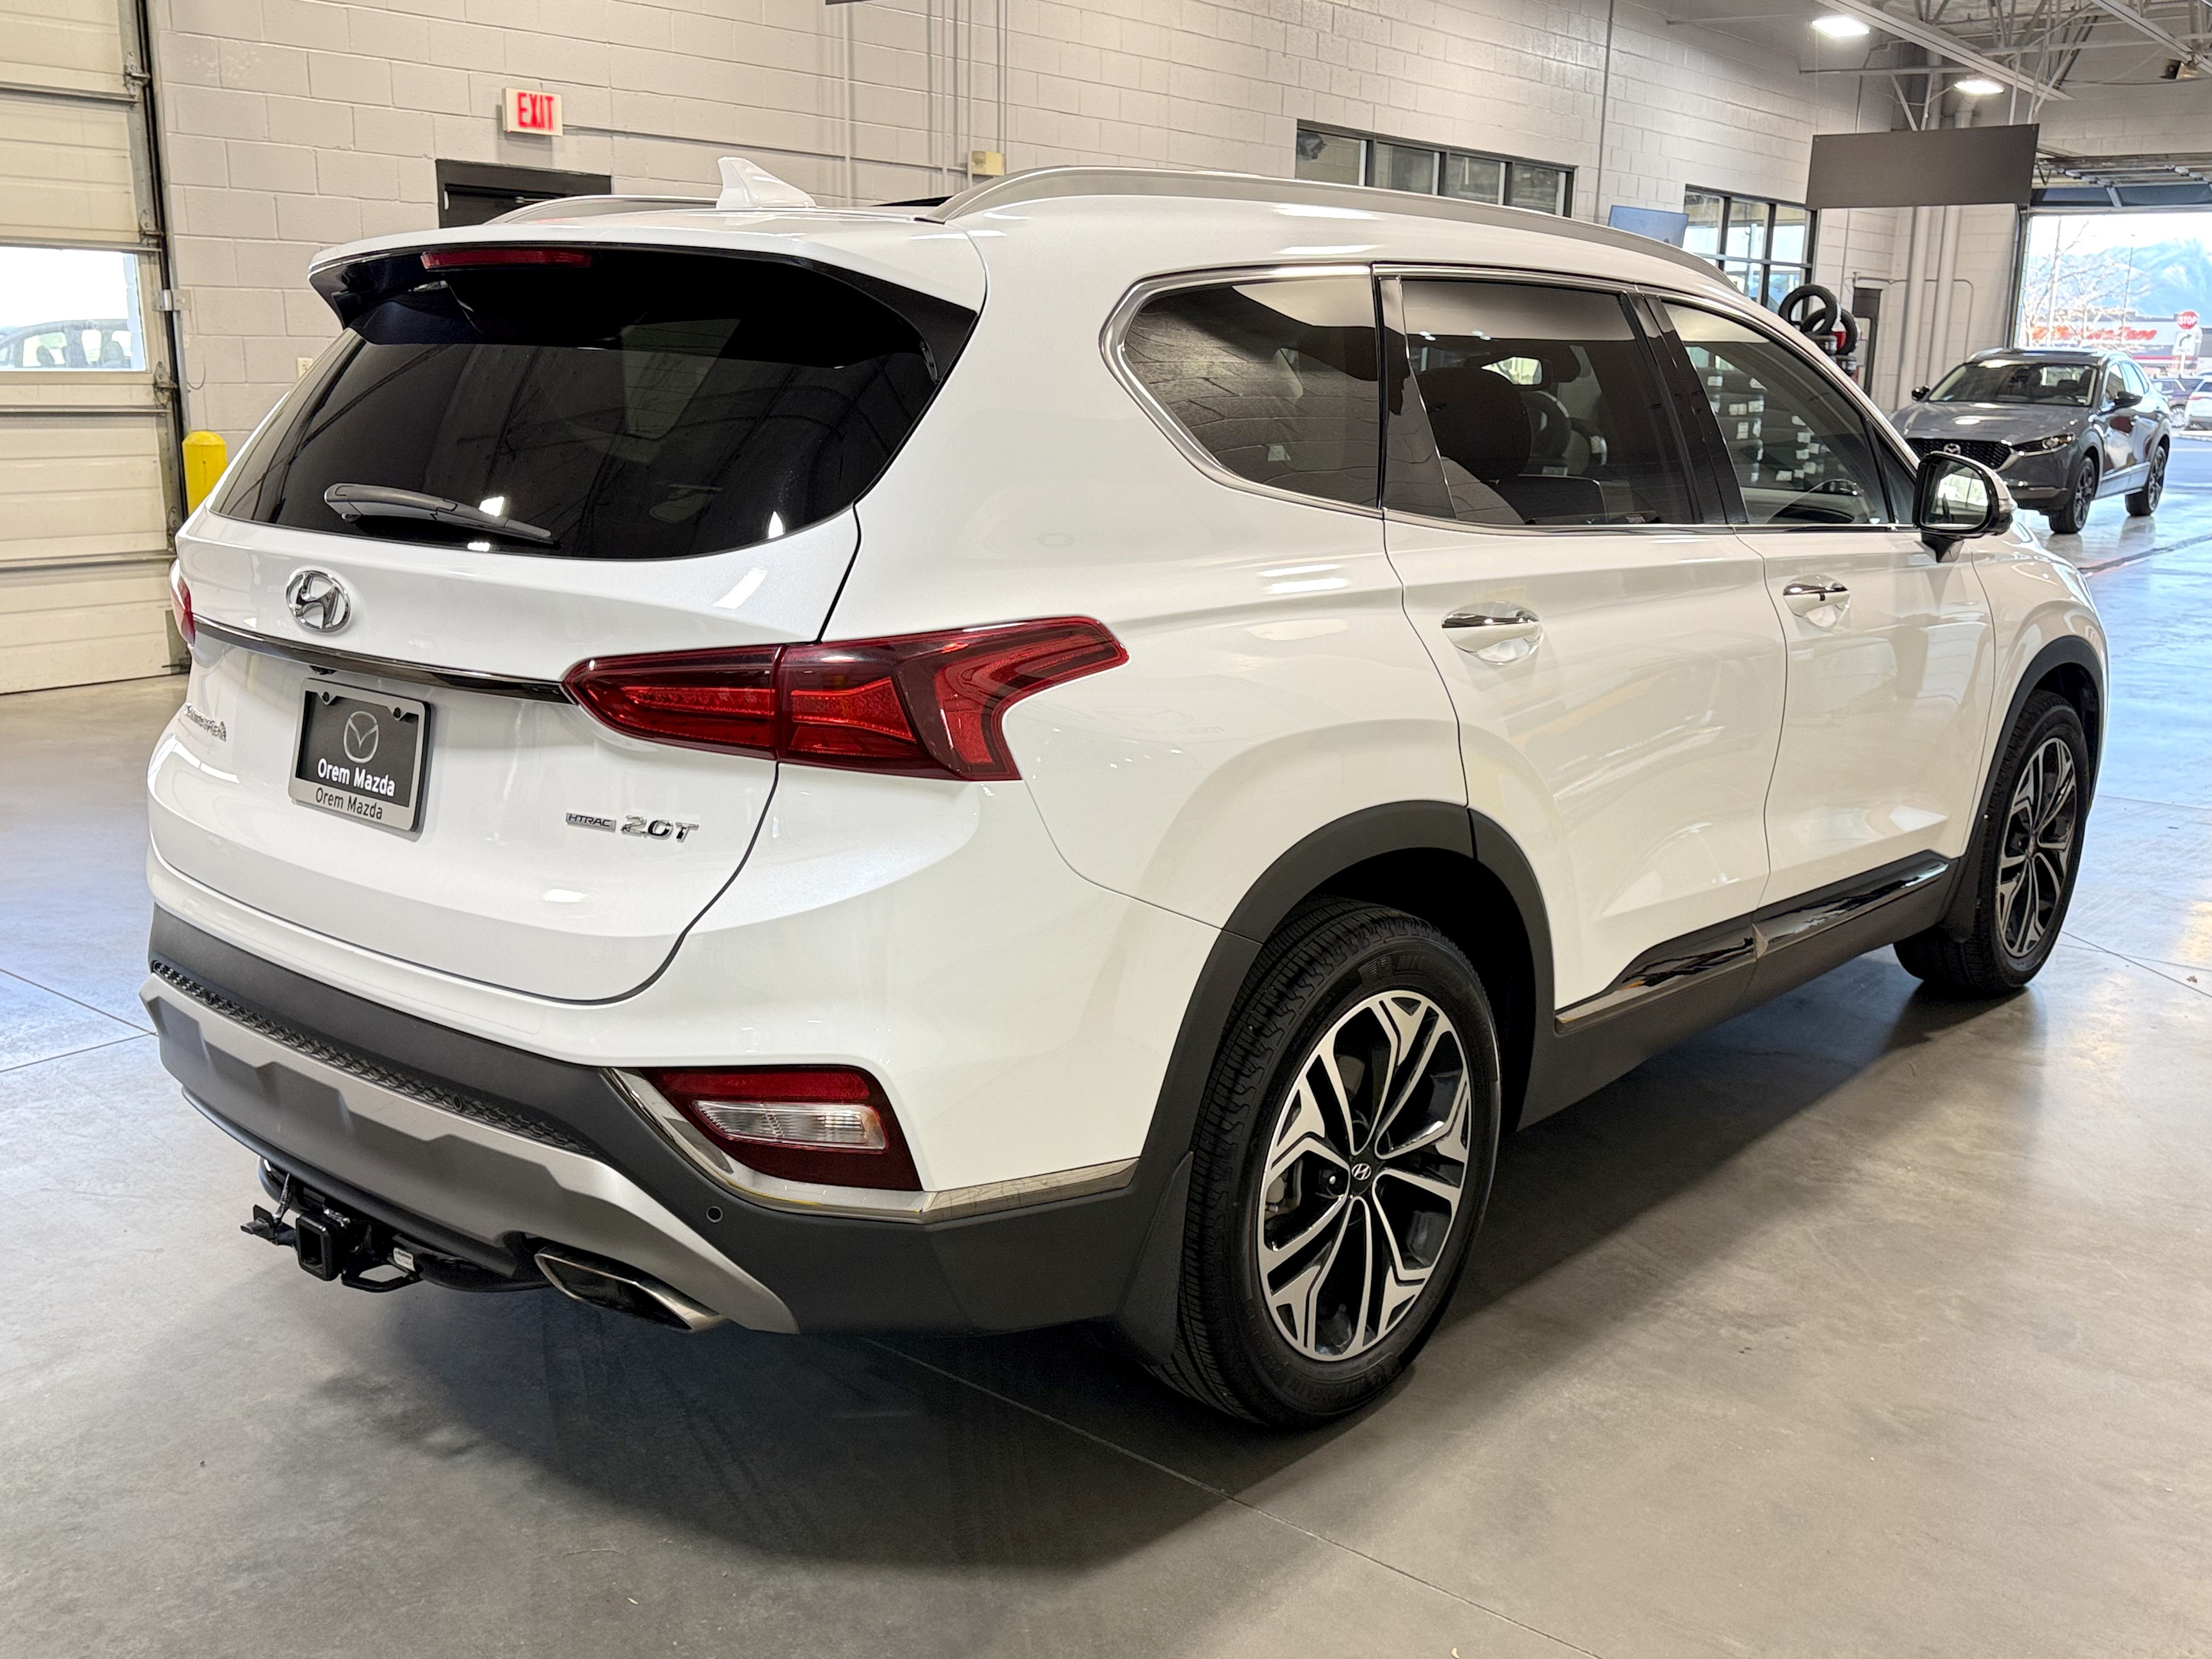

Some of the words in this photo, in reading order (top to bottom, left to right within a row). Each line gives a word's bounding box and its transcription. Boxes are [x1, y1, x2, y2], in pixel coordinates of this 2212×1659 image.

[517, 92, 554, 132] EXIT
[2177, 315, 2198, 325] STOP
[317, 758, 351, 785] Orem
[353, 767, 396, 797] Mazda
[315, 787, 344, 809] Orem
[347, 795, 383, 820] Mazda
[568, 813, 611, 827] HTRAC
[620, 815, 699, 843] 2.0T
